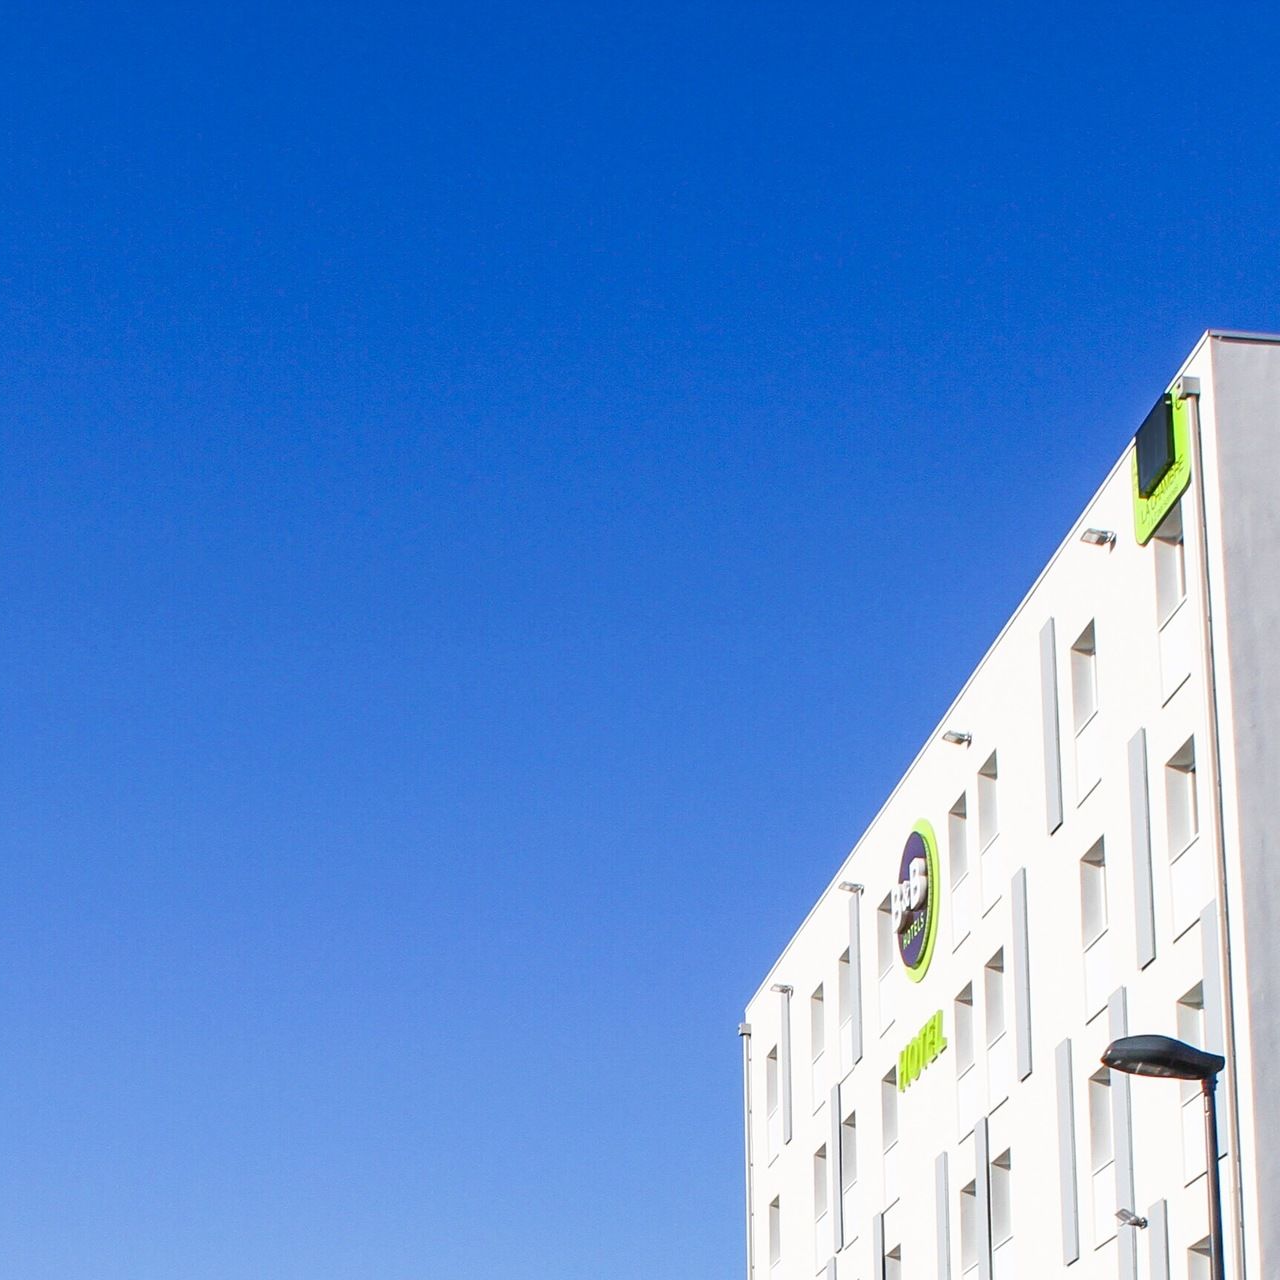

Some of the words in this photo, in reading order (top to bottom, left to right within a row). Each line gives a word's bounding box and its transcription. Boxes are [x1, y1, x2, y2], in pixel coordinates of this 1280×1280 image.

[890, 857, 928, 934] B&B
[902, 911, 925, 950] HOTELS
[898, 1009, 948, 1093] HOTEL
